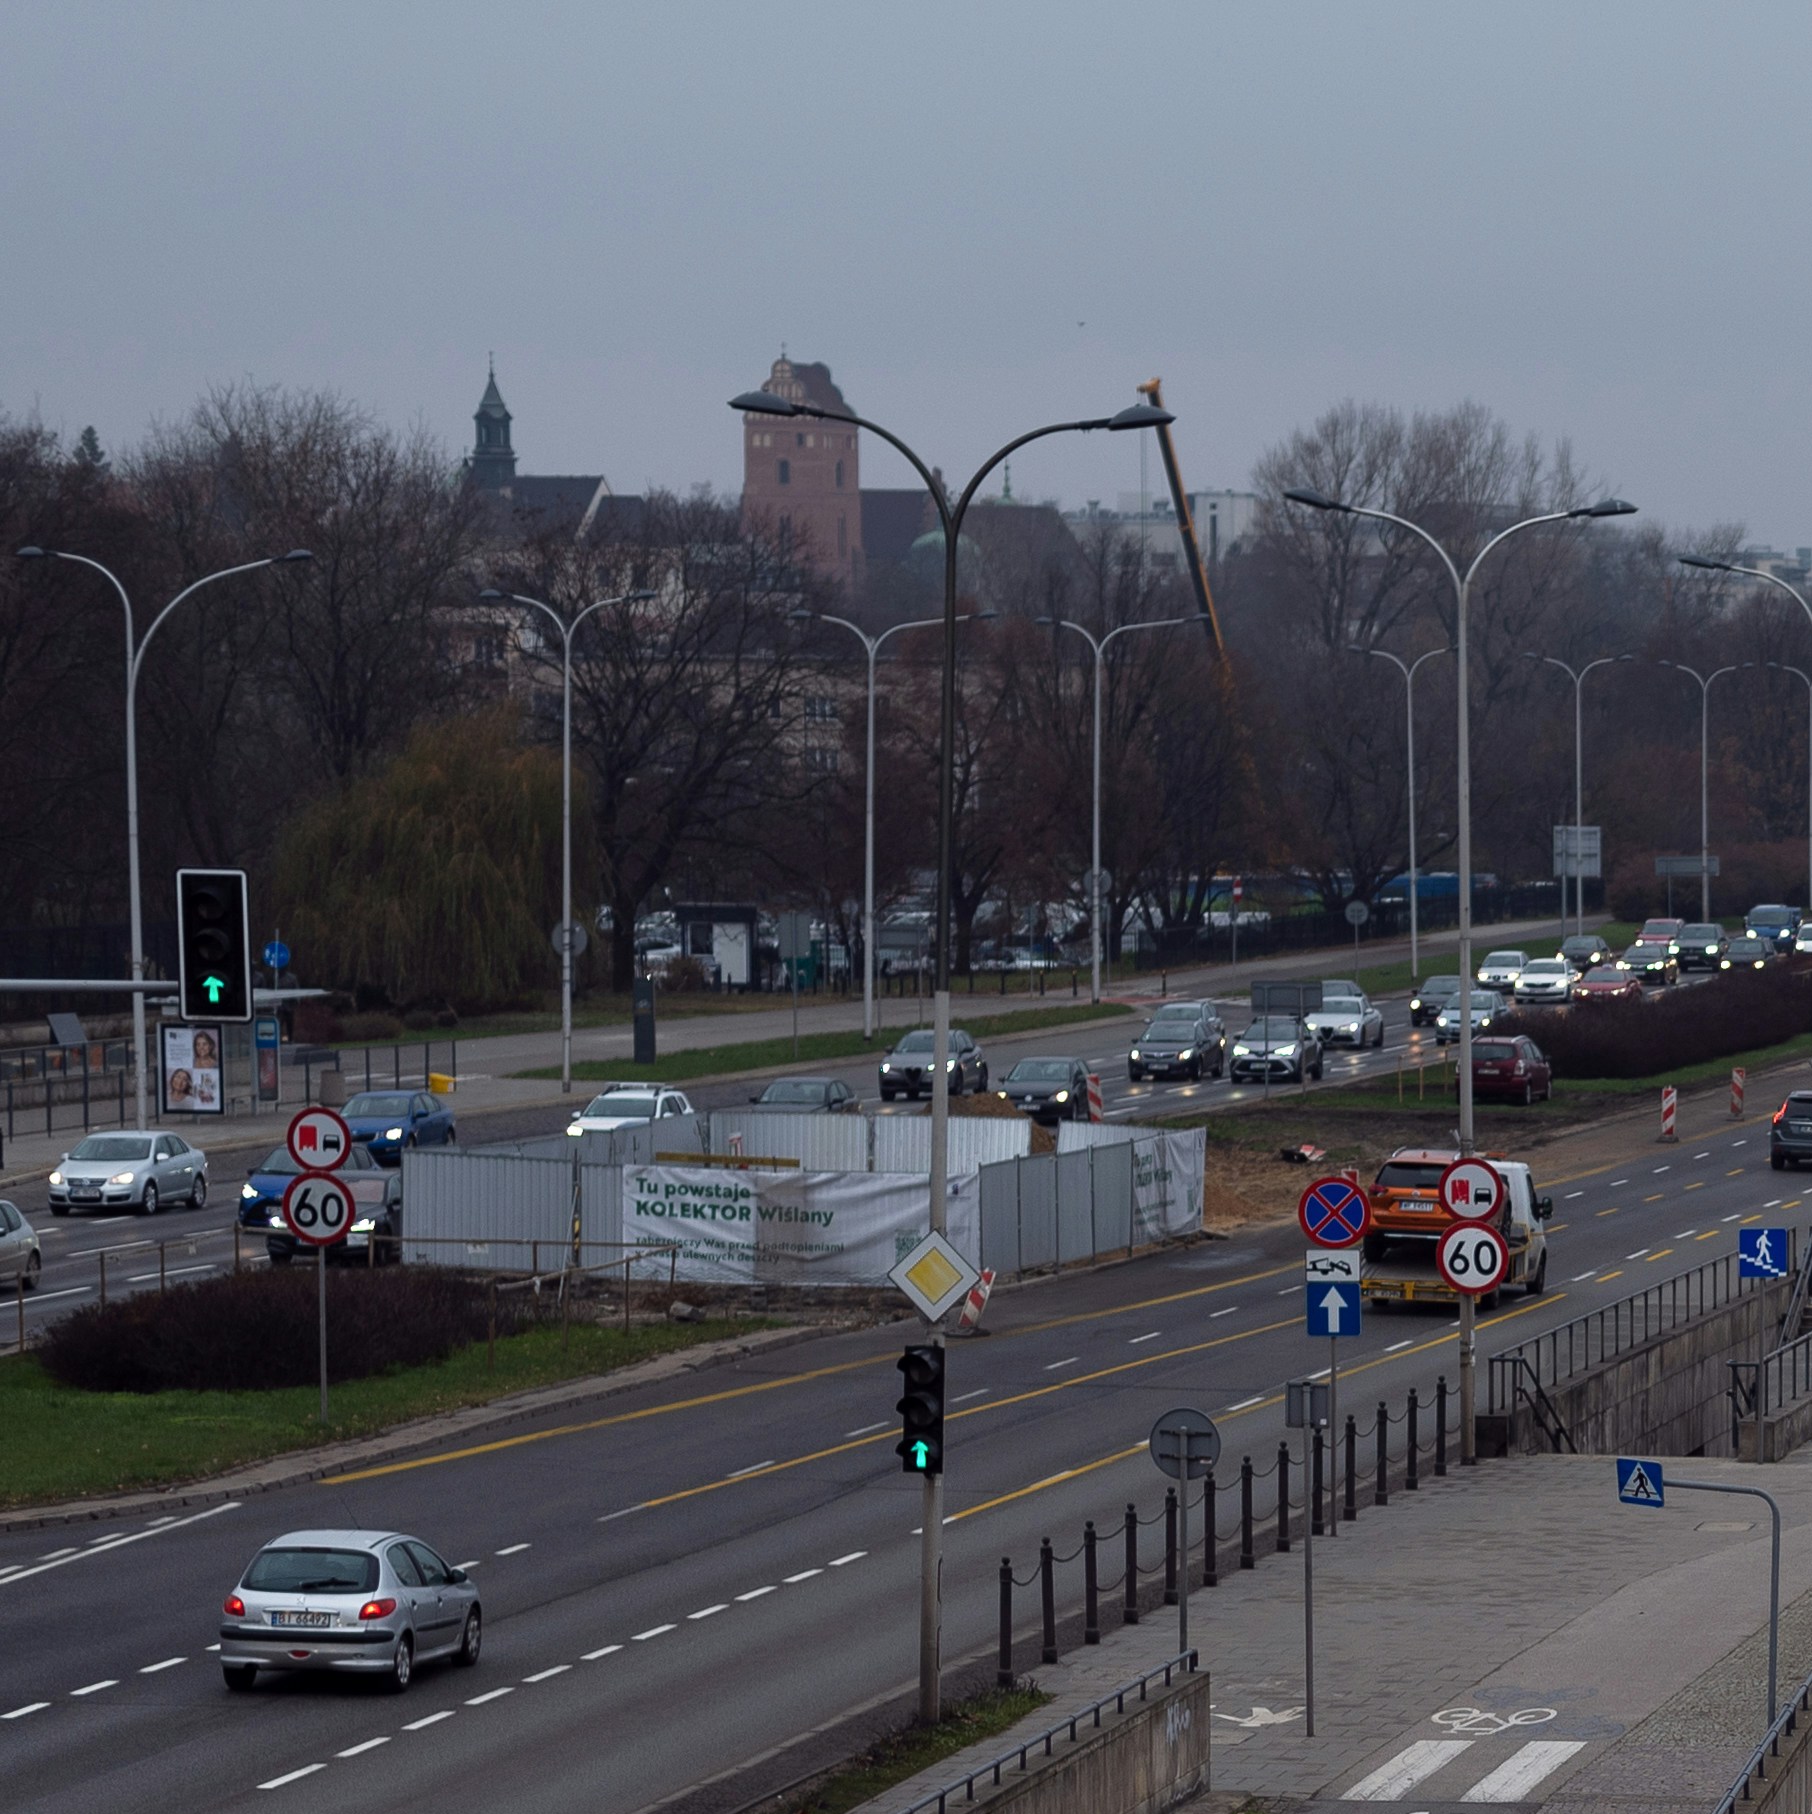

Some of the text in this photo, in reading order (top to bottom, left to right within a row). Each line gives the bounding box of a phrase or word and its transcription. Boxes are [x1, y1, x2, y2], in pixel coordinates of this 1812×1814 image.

[636, 1178, 750, 1203] Tu powstaje
[294, 1187, 343, 1228] 60
[636, 1201, 834, 1227] KOLEKTOR Wiślany
[1449, 1240, 1497, 1275] 60
